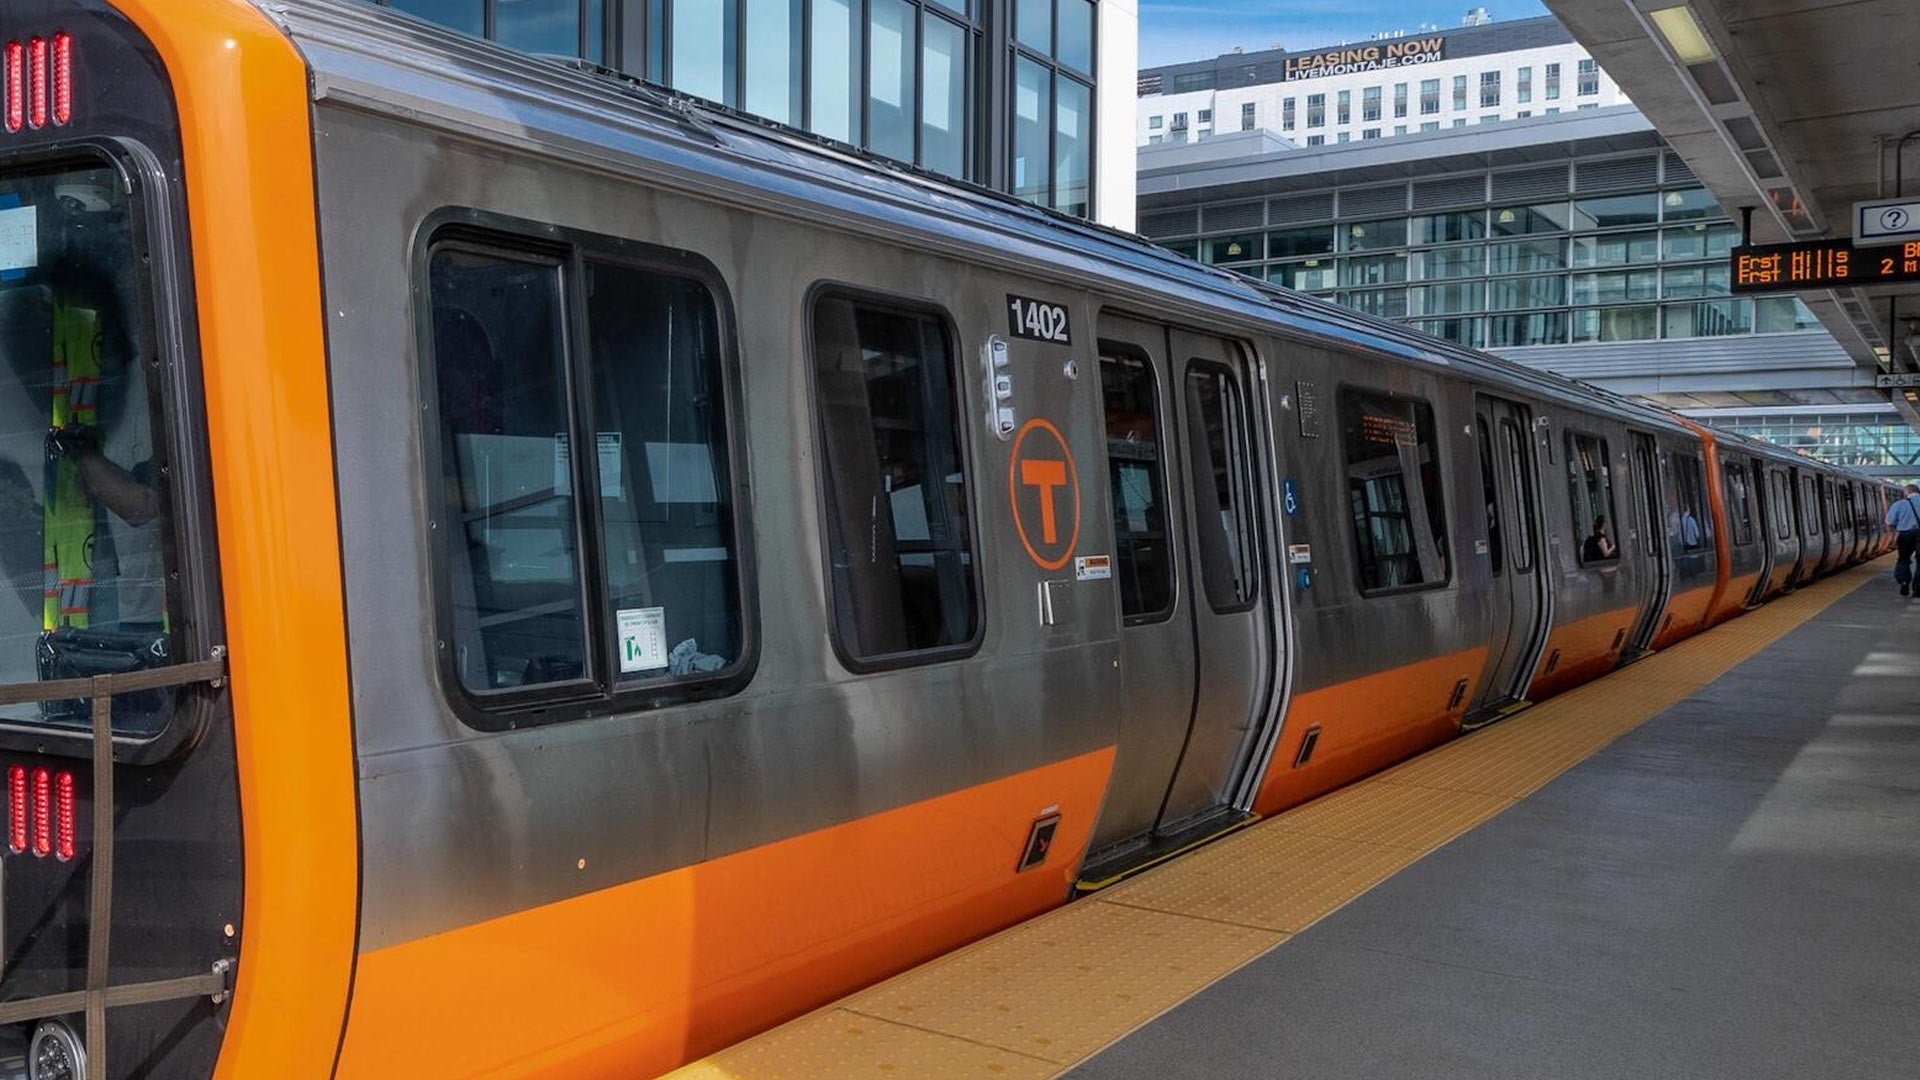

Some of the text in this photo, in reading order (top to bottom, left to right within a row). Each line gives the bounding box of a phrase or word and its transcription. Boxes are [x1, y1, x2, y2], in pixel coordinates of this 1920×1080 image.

[1285, 37, 1443, 72] LEASING NOW
[1285, 51, 1441, 82] LIVEMONTAJE.COM
[1792, 249, 1849, 266] Hills
[1792, 263, 1849, 281] Hills
[1881, 258, 1894, 274] 2
[1011, 298, 1068, 341] 1402
[1021, 459, 1067, 544] T
